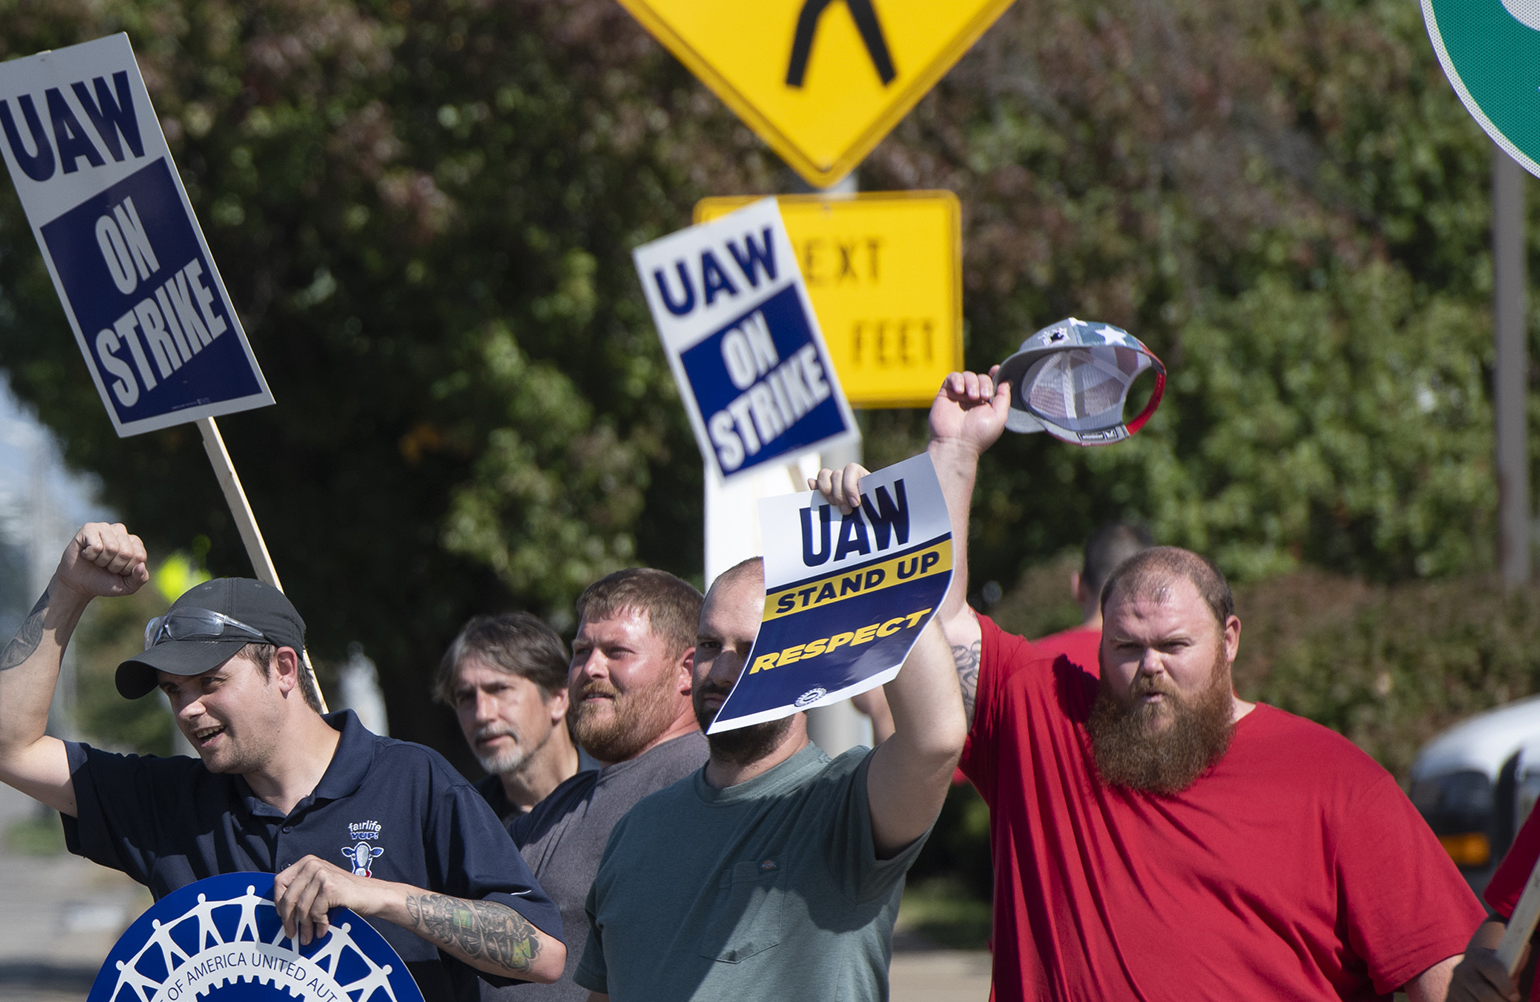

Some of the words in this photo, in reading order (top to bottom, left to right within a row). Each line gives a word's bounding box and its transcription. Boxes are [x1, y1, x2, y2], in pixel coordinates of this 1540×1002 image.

[95, 196, 160, 295] ON
[653, 226, 778, 317] UAW
[796, 238, 882, 283] EXT
[95, 257, 228, 407] STRIKE
[720, 310, 779, 391] ON
[852, 318, 935, 366] FEET
[707, 342, 831, 471] STRIKE
[799, 478, 910, 567] UAW
[775, 567, 886, 614] STAND
[896, 550, 941, 580] UP
[748, 607, 933, 675] RESPECT
[348, 820, 382, 832] fairlife
[350, 831, 379, 840] YUP!
[167, 978, 185, 1001] OF
[186, 952, 247, 986] AMERICA
[251, 952, 307, 982] UNITED
